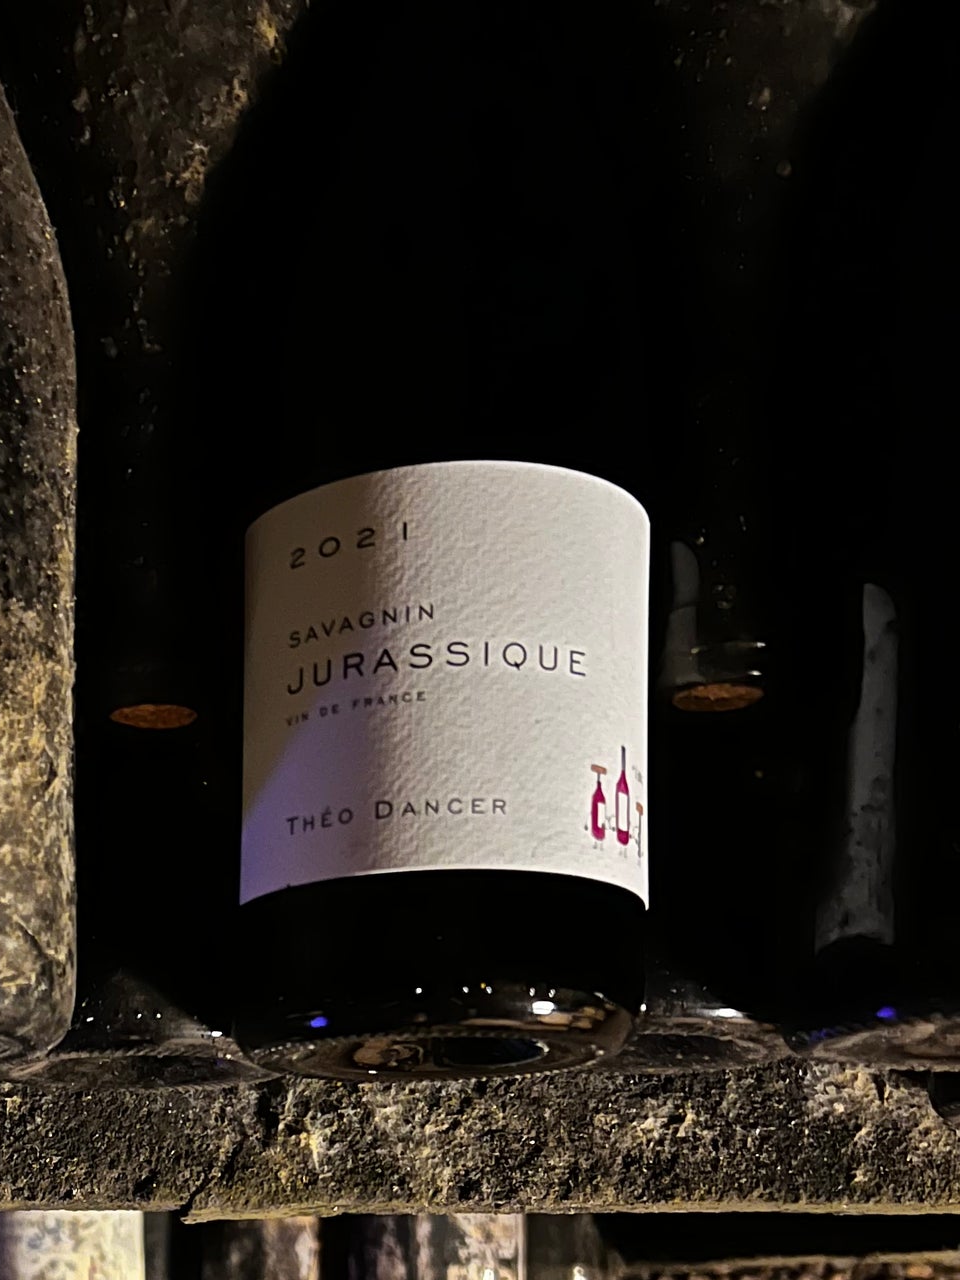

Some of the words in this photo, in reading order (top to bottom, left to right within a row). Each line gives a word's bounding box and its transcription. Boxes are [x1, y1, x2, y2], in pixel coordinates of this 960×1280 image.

[289, 521, 408, 569] 2021
[289, 603, 435, 649] SAVAGNIN
[287, 641, 587, 695] JURASSIQUE
[286, 712, 310, 727] VIN
[319, 703, 340, 717] DE
[352, 691, 427, 710] FRANCE
[286, 806, 354, 835] THÉO
[375, 799, 507, 821] DANCER
